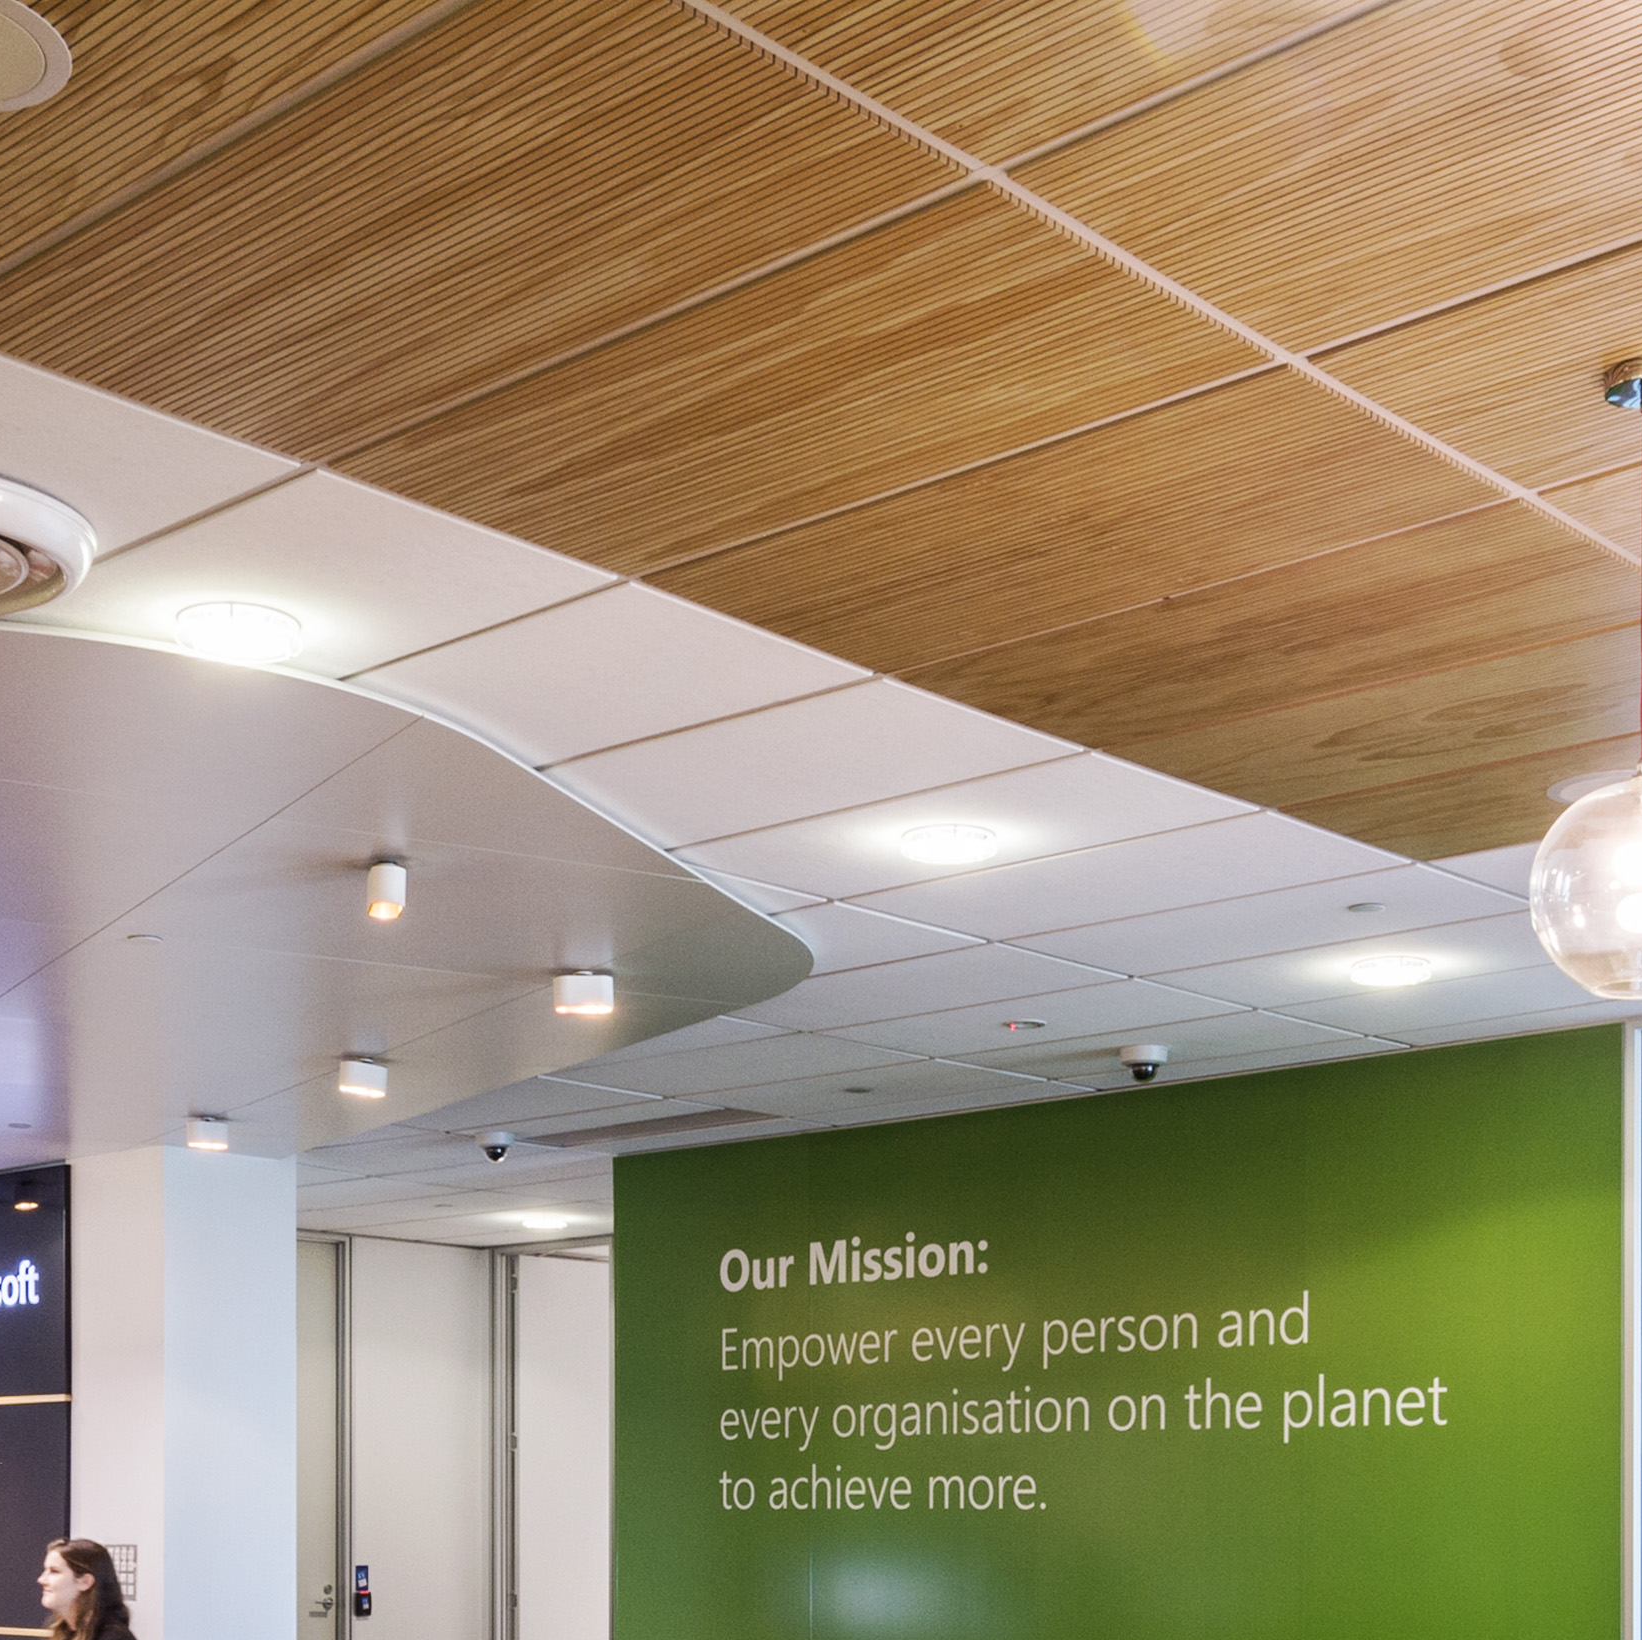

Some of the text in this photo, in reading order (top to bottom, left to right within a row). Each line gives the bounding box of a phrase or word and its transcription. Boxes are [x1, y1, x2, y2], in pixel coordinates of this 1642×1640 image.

[719, 1231, 989, 1293] Our Mission:
[721, 1289, 1309, 1382] Empower every person and
[719, 1372, 1448, 1452] every organisation on the planet
[718, 1463, 1047, 1511] to achieve more.
